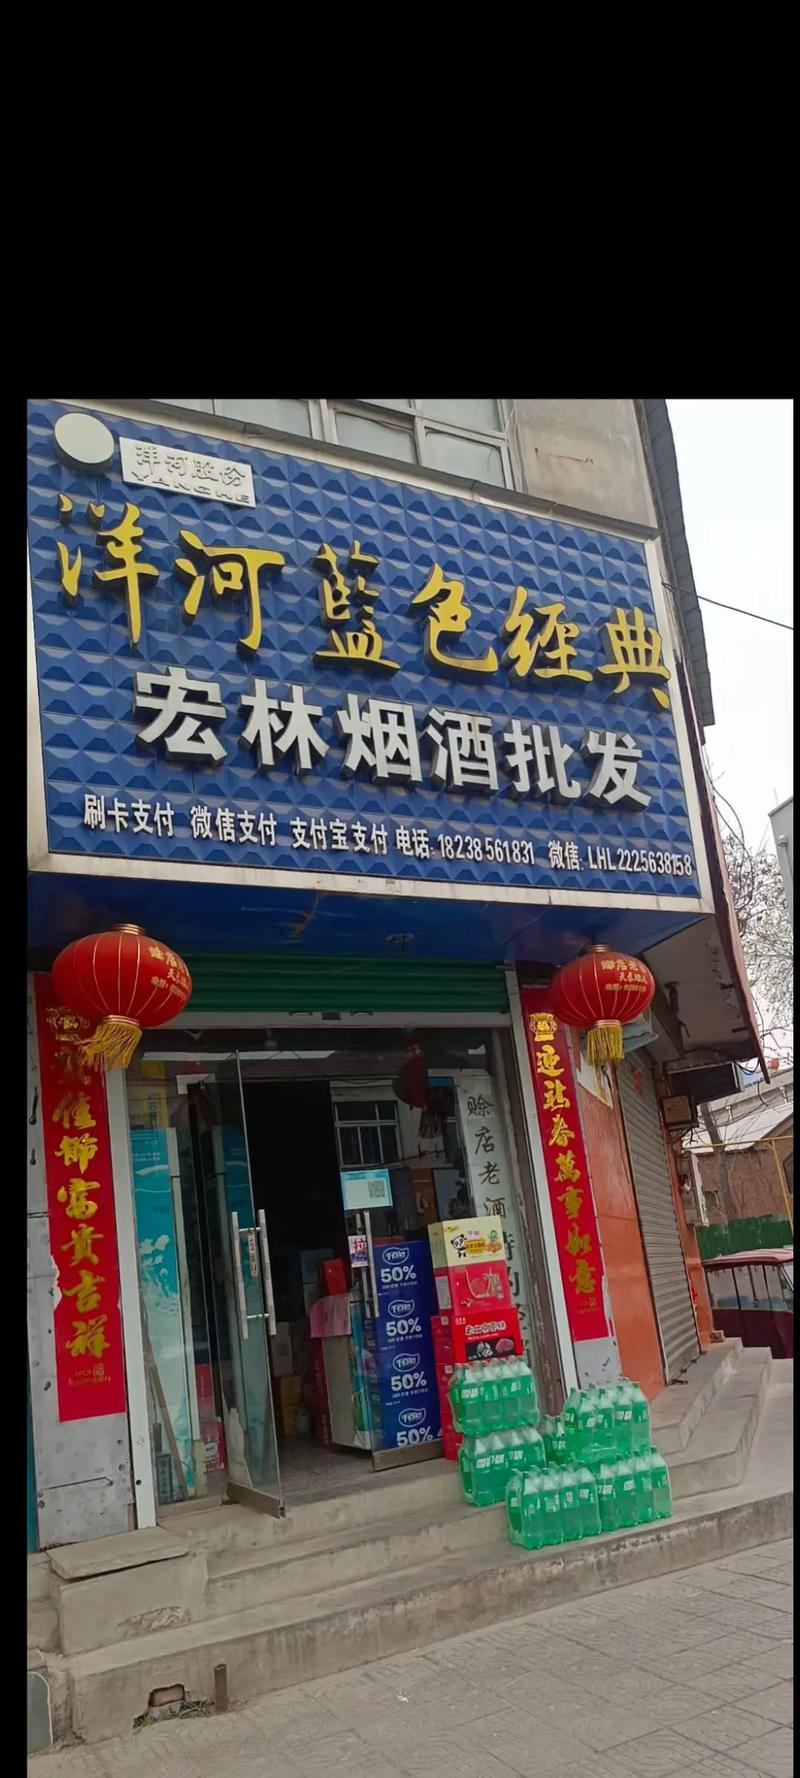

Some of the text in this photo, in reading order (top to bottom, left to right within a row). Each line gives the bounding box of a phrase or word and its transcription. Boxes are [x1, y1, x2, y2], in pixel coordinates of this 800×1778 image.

[135, 445, 246, 487] 洋河股份
[135, 665, 653, 809] 宏林烟酒批发
[84, 793, 175, 838] 刷卡支付
[190, 805, 278, 847] 微信支付
[289, 816, 389, 856] 支付宝支付
[381, 1264, 417, 1283] 50%
[386, 1317, 422, 1336] 50%
[391, 1370, 428, 1391] 50%
[396, 1425, 433, 1447] 50%
